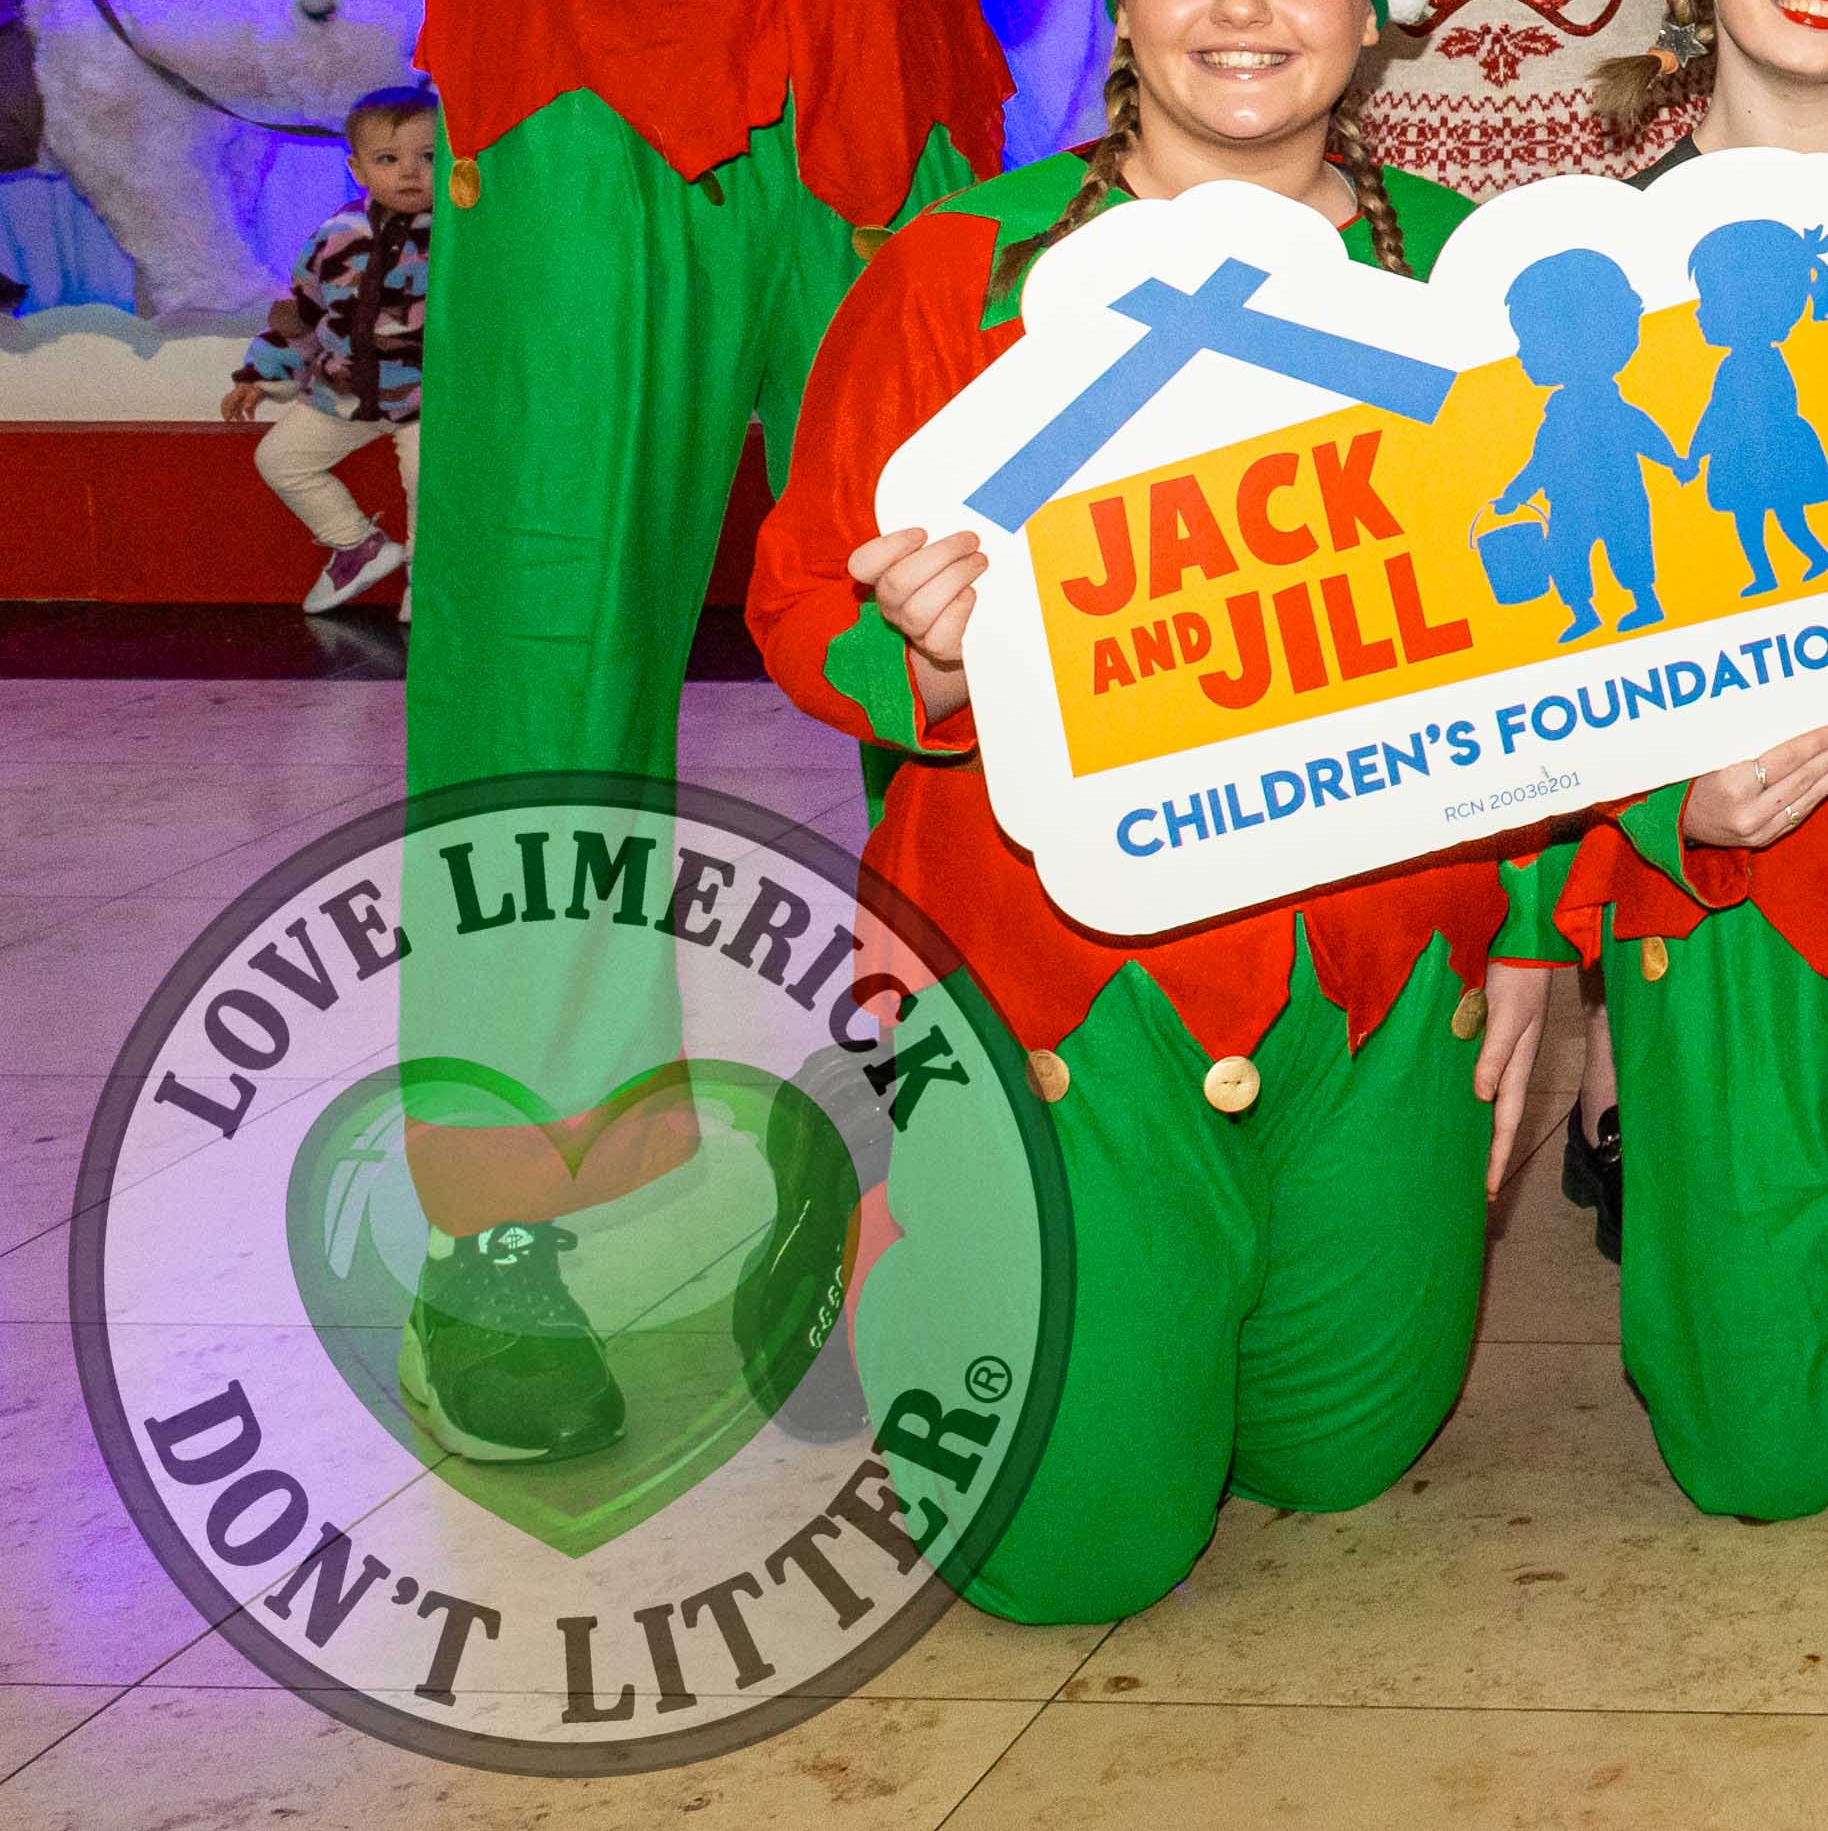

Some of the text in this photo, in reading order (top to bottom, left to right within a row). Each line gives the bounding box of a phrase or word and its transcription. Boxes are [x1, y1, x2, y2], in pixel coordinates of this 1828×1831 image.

[1061, 429, 1405, 617] JACK
[1093, 553, 1474, 710] AND JILL
[1116, 719, 1481, 859] CHILDREN'S
[1444, 771, 1582, 822] RCN 20036201
